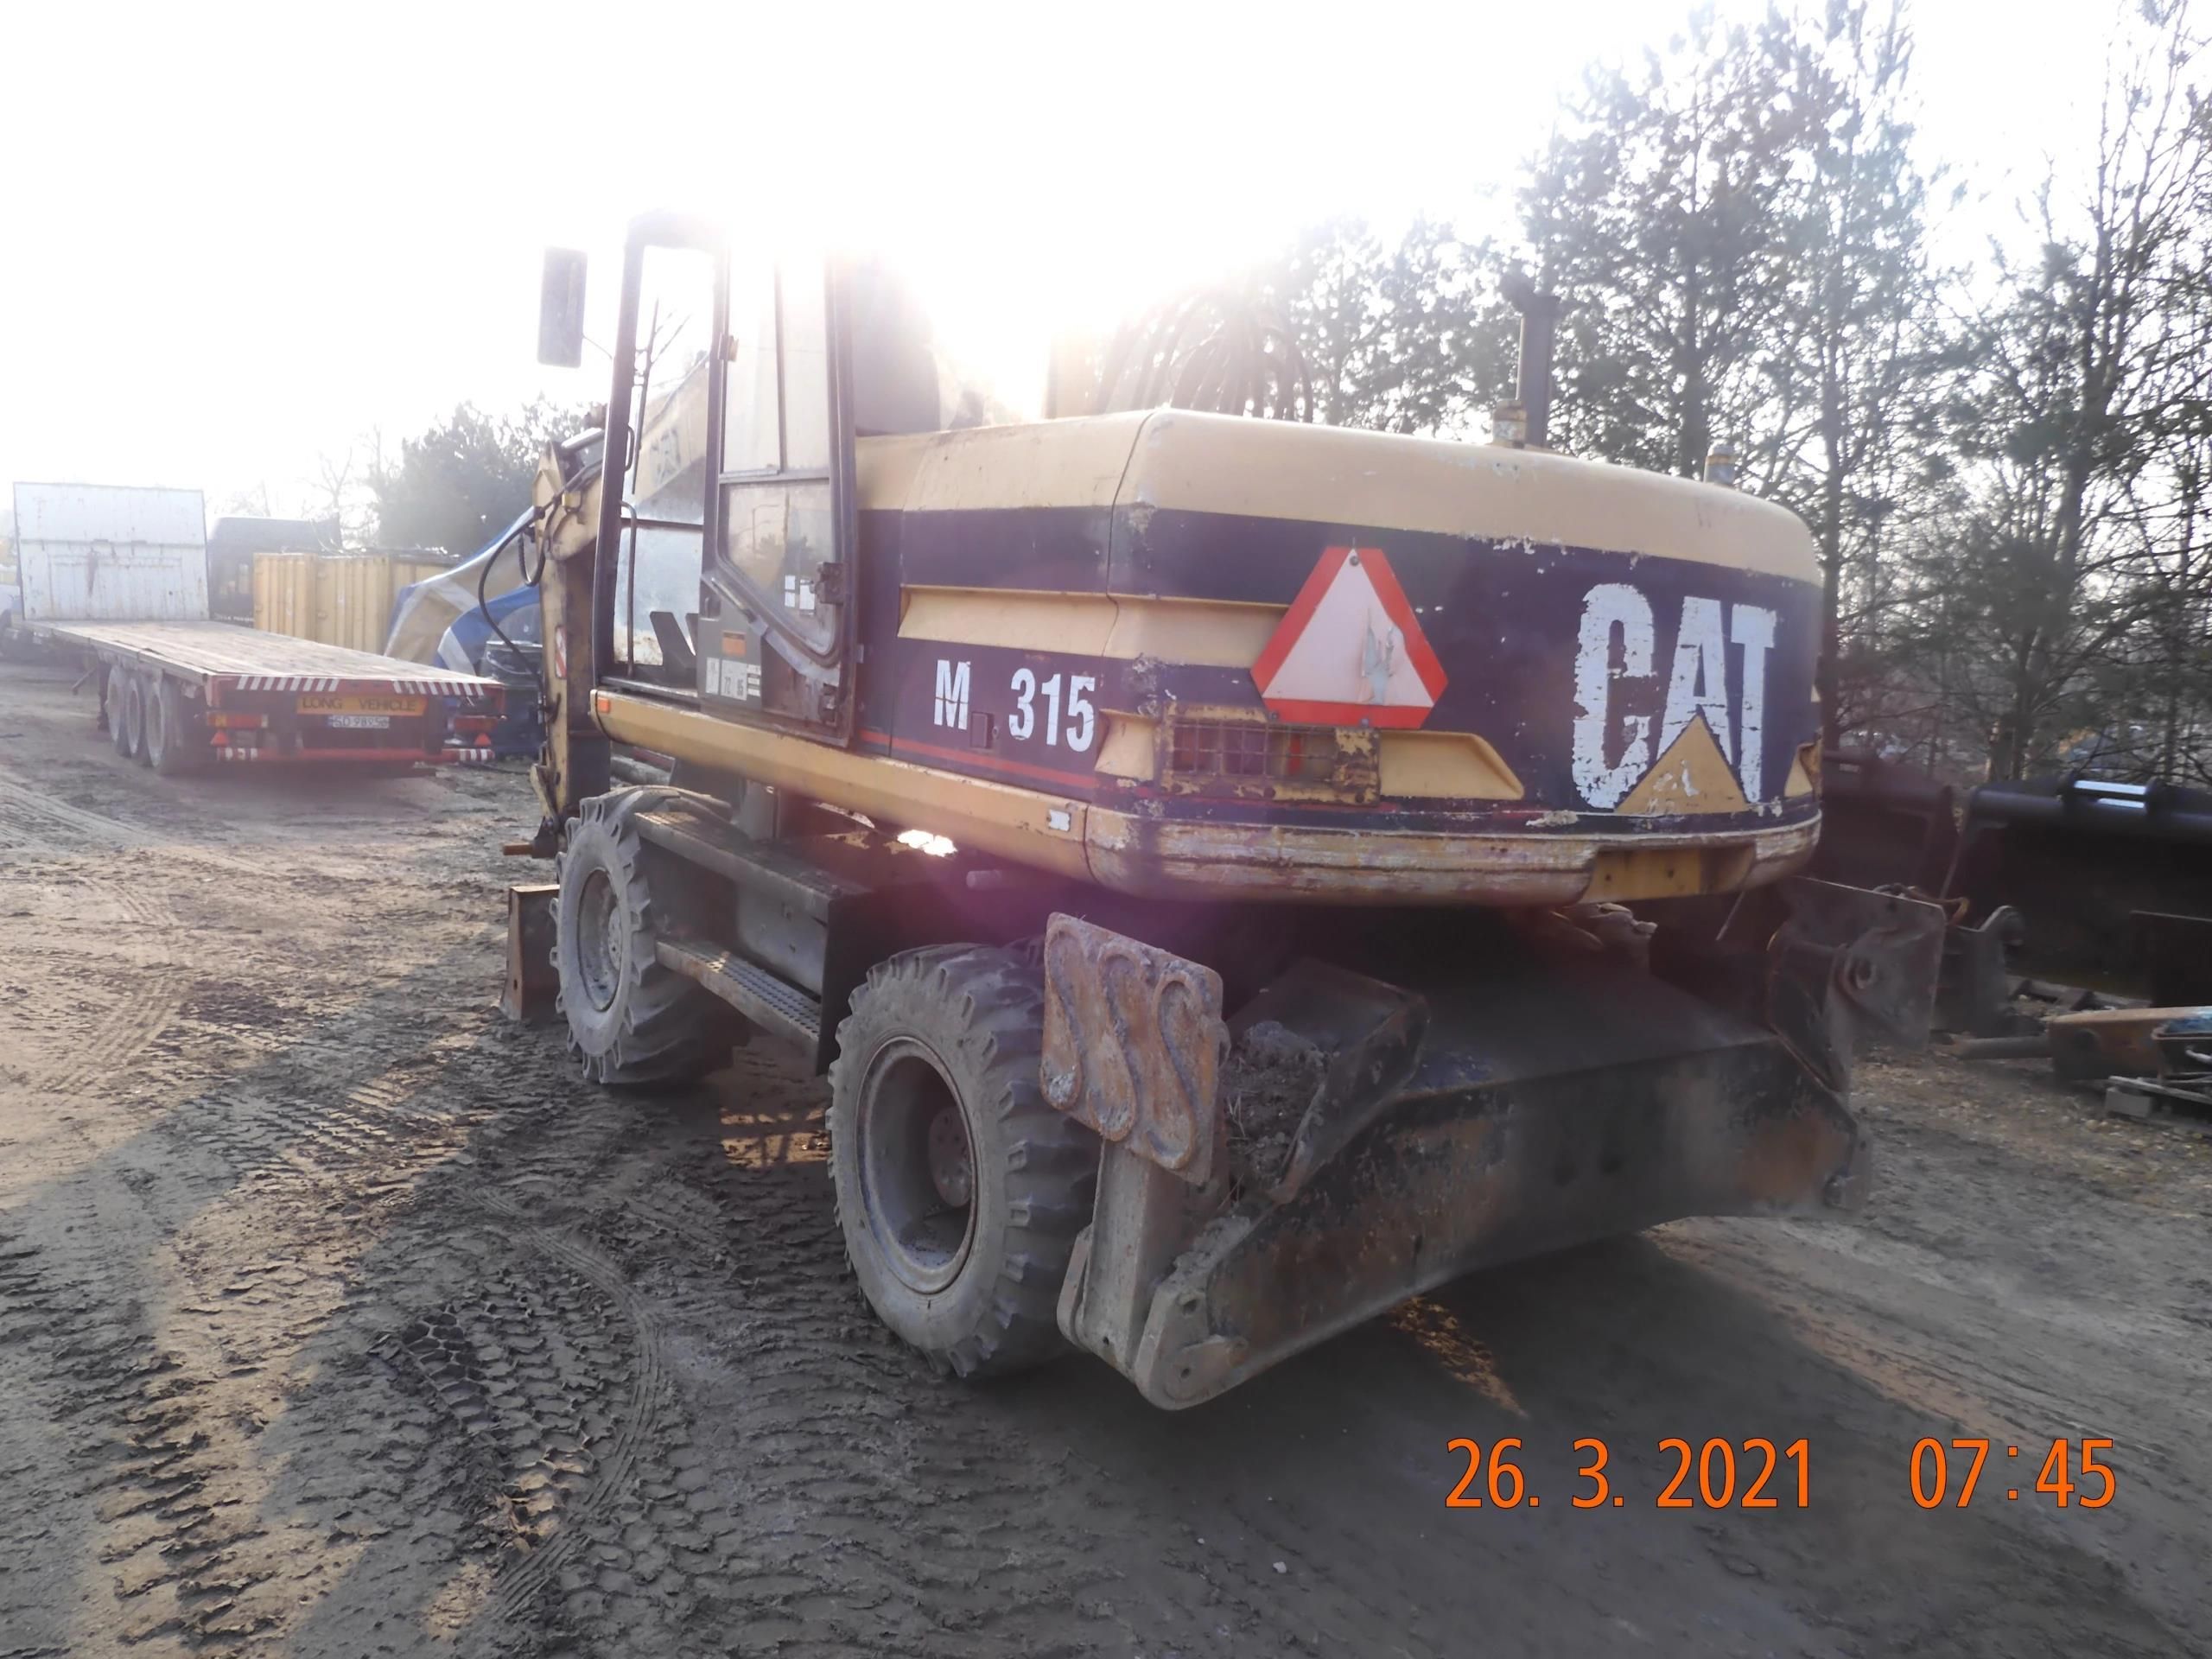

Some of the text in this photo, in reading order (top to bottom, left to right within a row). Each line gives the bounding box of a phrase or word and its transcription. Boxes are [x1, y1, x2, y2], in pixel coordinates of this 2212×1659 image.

[302, 697, 416, 712] LONG VEHICLE
[934, 659, 1096, 752] M 315
[1572, 583, 1777, 811] CAT
